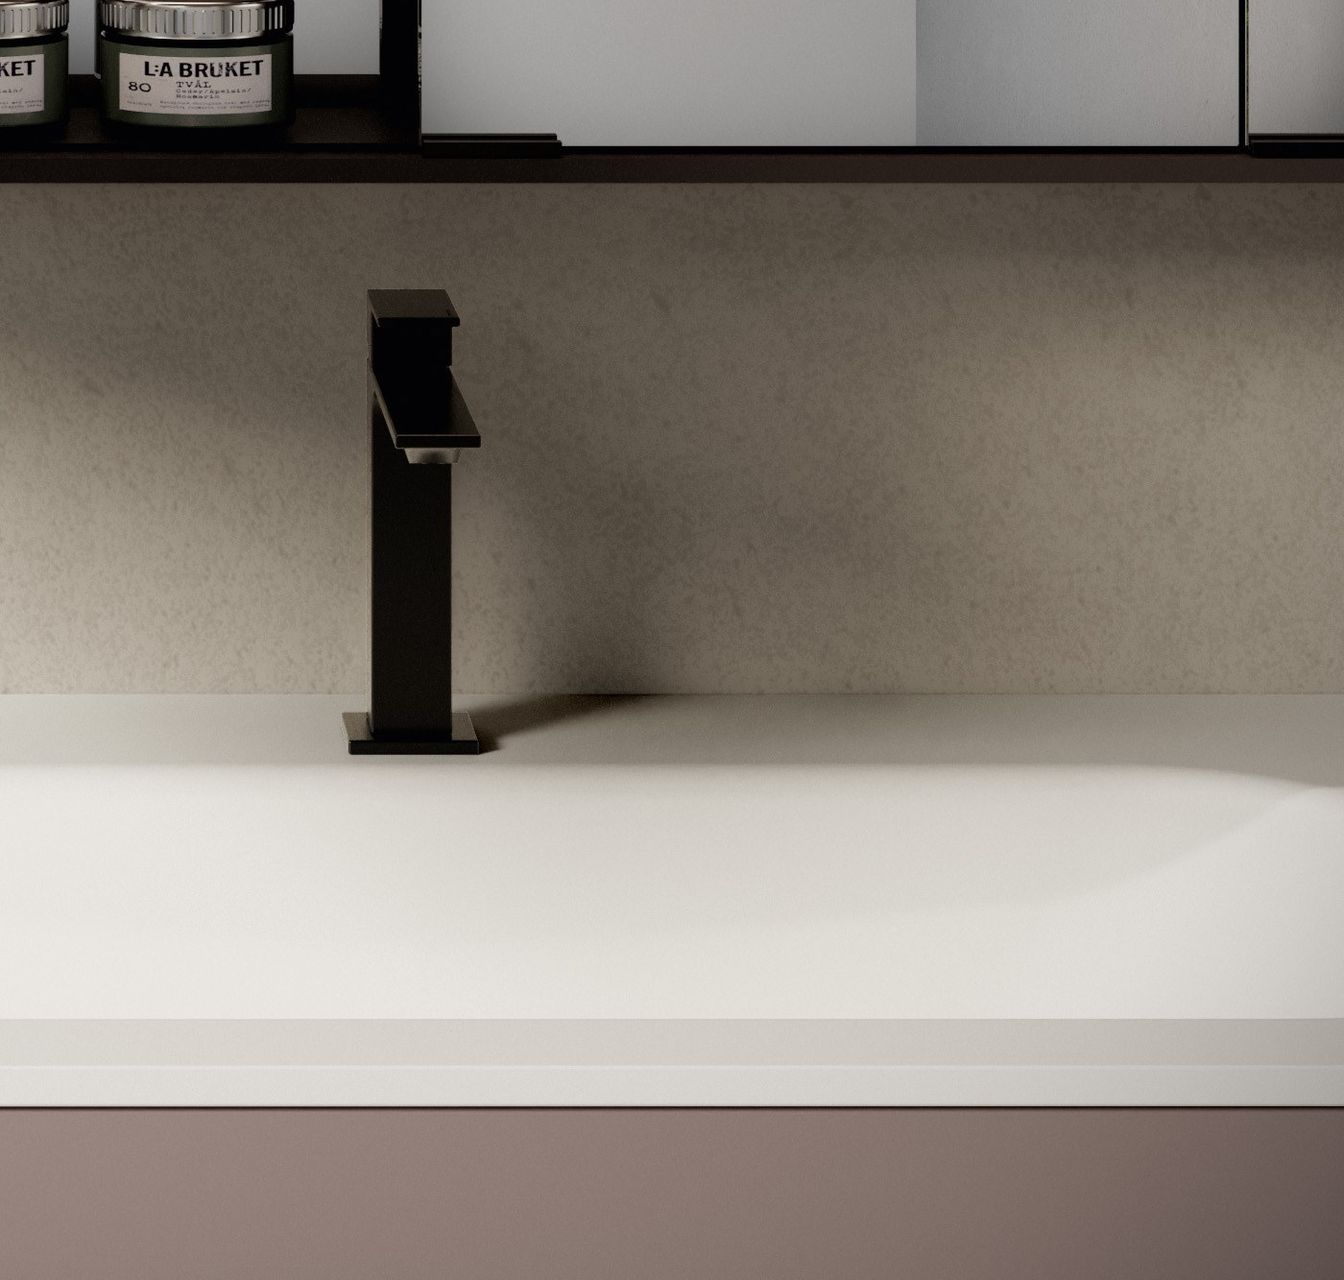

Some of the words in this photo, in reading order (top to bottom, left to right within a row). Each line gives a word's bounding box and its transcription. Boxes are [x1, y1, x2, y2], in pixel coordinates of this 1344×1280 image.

[144, 61, 174, 78] L:A
[179, 59, 264, 78] BRUKET
[128, 81, 151, 93] 80
